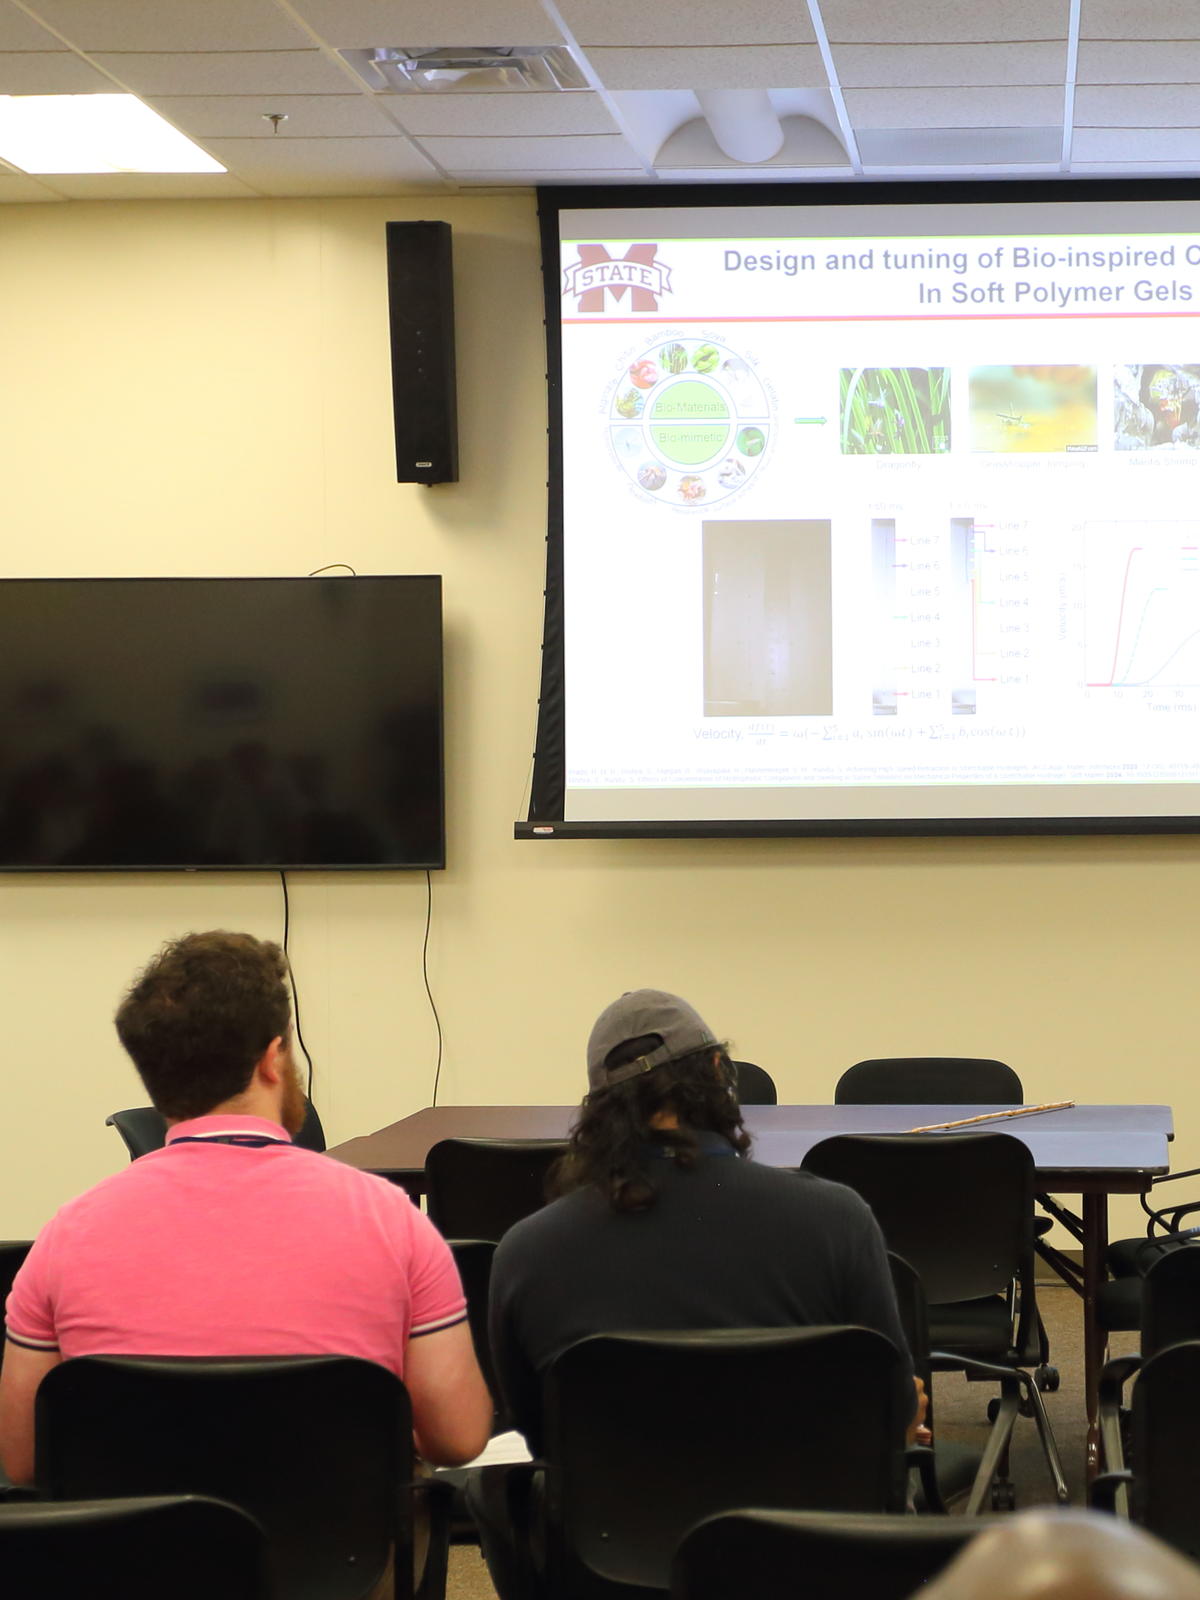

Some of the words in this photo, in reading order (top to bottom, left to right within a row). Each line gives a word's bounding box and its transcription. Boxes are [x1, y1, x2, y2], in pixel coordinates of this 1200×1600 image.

[723, 249, 816, 276] Design
[825, 248, 874, 270] and
[882, 248, 968, 274] tuning
[977, 246, 1005, 269] of
[1012, 245, 1176, 272] Bio-inspired
[582, 264, 653, 287] STATE
[918, 283, 942, 304] In
[952, 281, 1005, 304] Soft
[1014, 281, 1125, 308] Polymer
[1134, 280, 1194, 302] Gels
[655, 401, 726, 413] Bio-Materials
[658, 432, 724, 443] Bio-mimetic
[1146, 702, 1171, 713] Time
[692, 727, 744, 742] Velocity,
